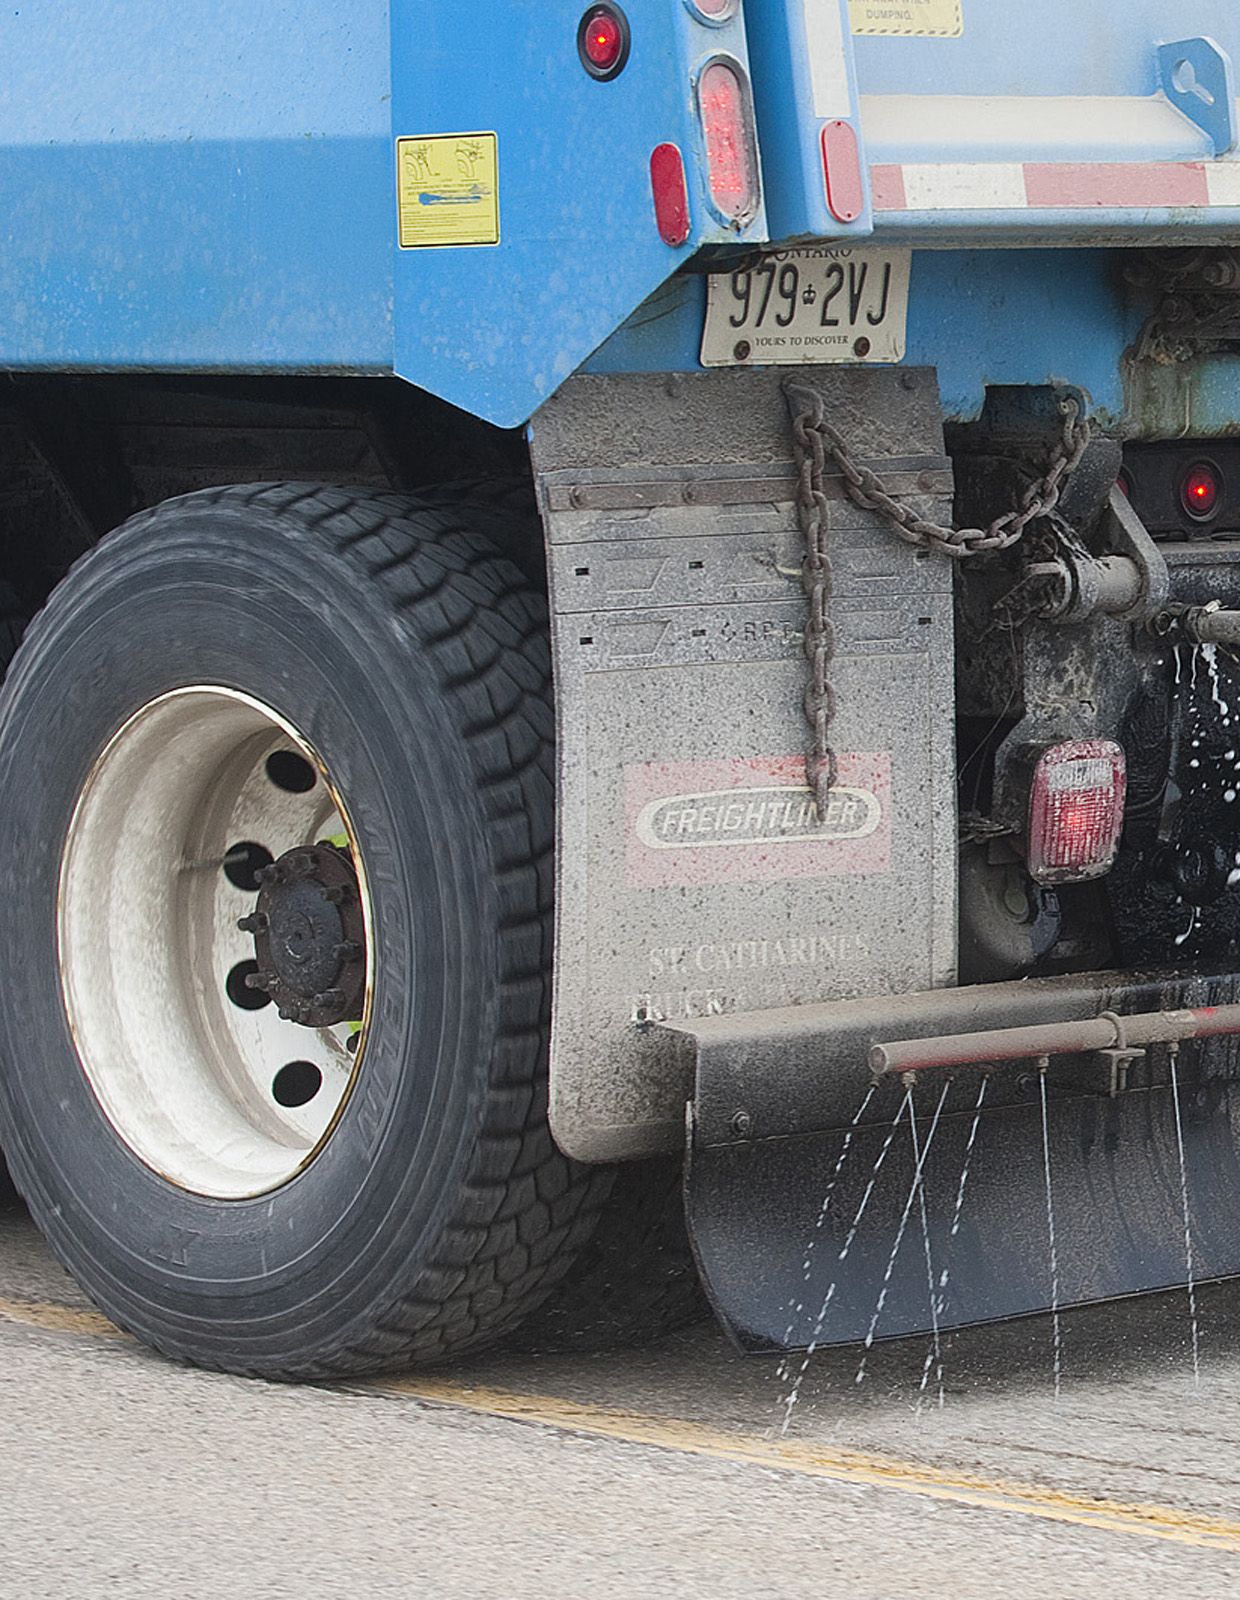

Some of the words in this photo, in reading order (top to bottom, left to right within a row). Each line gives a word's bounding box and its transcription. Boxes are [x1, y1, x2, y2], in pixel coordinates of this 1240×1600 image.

[729, 261, 799, 328] 979
[820, 261, 891, 327] 2VJ
[755, 336, 787, 346] YOURS
[790, 336, 803, 346] TO
[804, 335, 849, 346] DISCOVER
[660, 799, 859, 836] FREIGHTLINER
